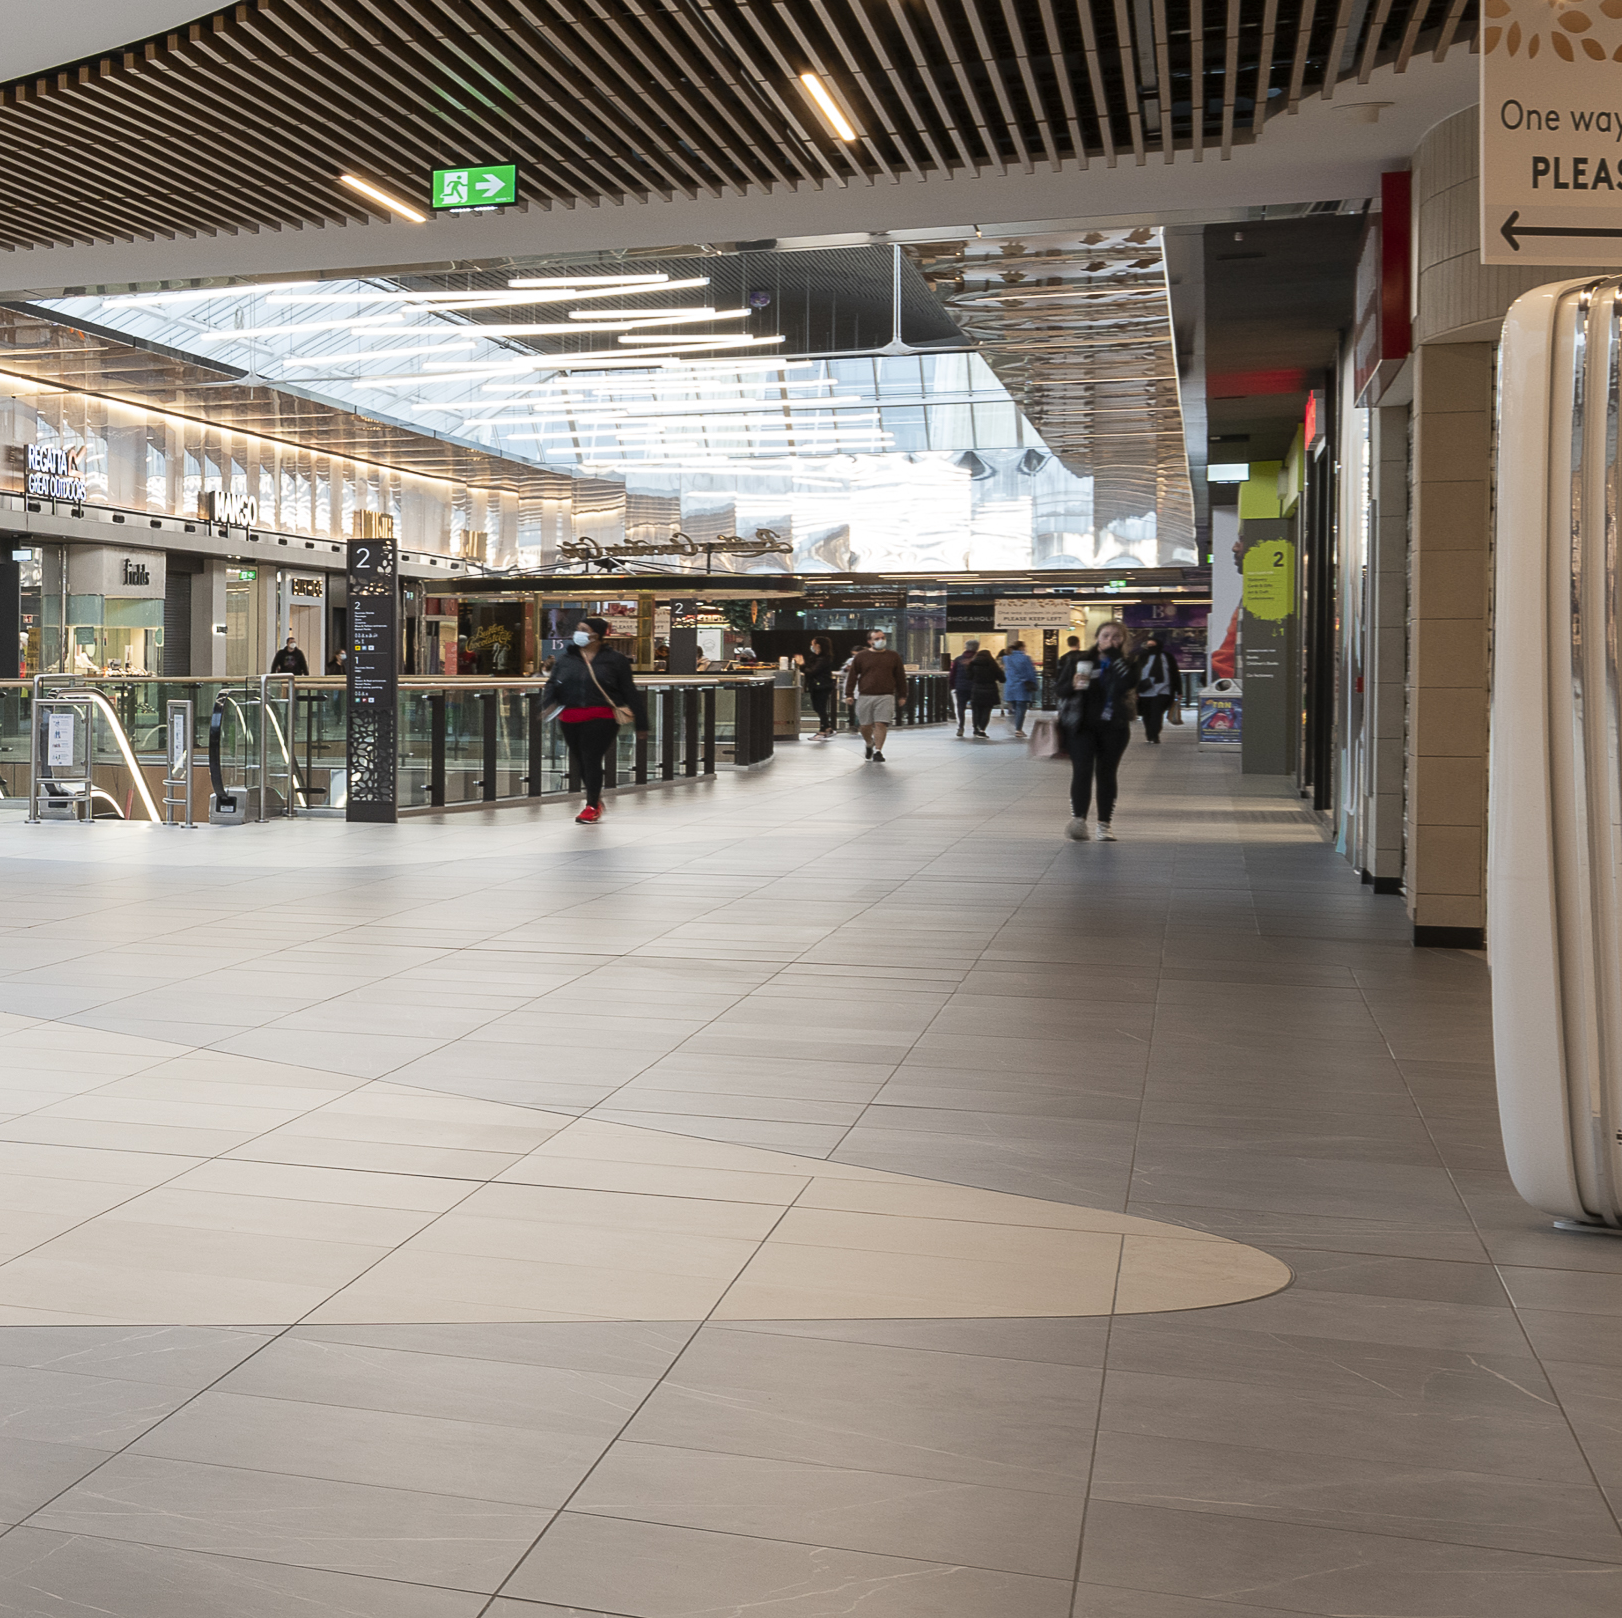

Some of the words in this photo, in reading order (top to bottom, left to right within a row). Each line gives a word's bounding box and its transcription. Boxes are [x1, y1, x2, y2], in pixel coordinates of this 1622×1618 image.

[1500, 98, 1561, 131] One
[1570, 110, 1622, 143] way
[27, 443, 68, 476] REGATTA
[28, 473, 50, 495] GREAT
[50, 476, 87, 502] OUTDOORS
[214, 490, 257, 527] MANGO
[355, 547, 371, 569] 2
[1273, 551, 1285, 568] 2
[123, 558, 150, 586] fields
[354, 601, 361, 610] 2
[675, 602, 684, 614] 2
[551, 639, 564, 650] 15
[354, 656, 359, 665] 1
